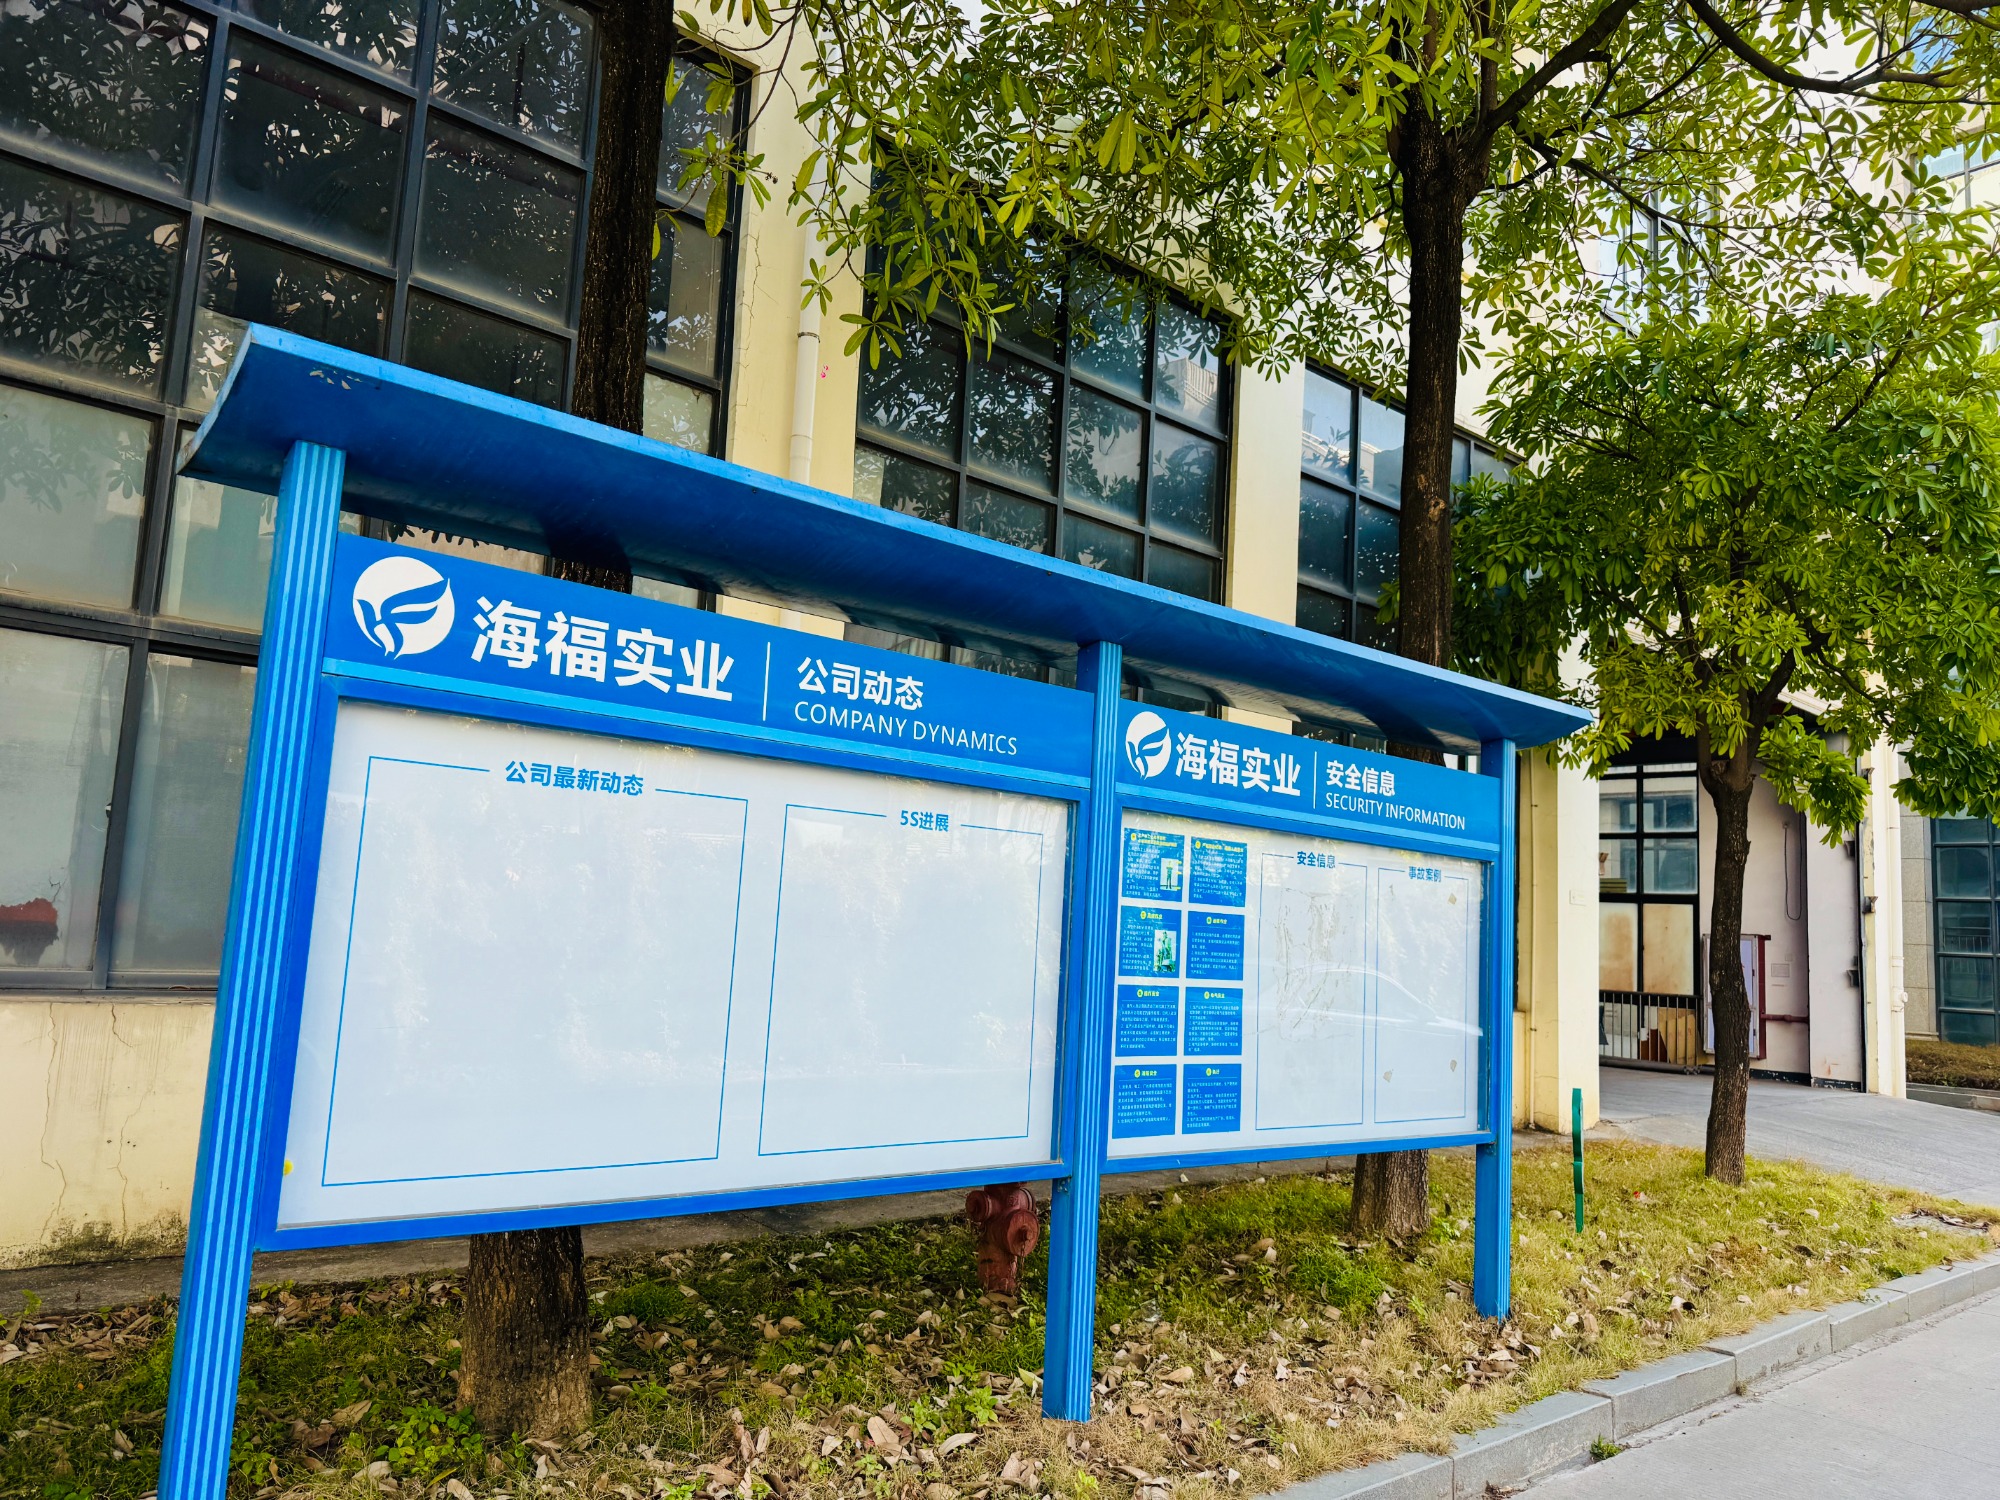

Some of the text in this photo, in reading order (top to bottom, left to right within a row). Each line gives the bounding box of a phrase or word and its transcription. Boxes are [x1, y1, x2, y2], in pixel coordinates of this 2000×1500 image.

[471, 596, 735, 701] 海福实业
[796, 657, 924, 711] 公司动态
[795, 699, 1017, 755] COMPANY DYNAMICS
[506, 760, 644, 796] 公司最新动态
[1176, 731, 1300, 796] 海福实业
[1326, 760, 1396, 797] 安全信息
[900, 809, 949, 832] 5S进展
[1325, 791, 1466, 830] SECURITY INFORMATION
[1296, 851, 1336, 869] 安全信息
[1408, 866, 1442, 882] 事故案例
